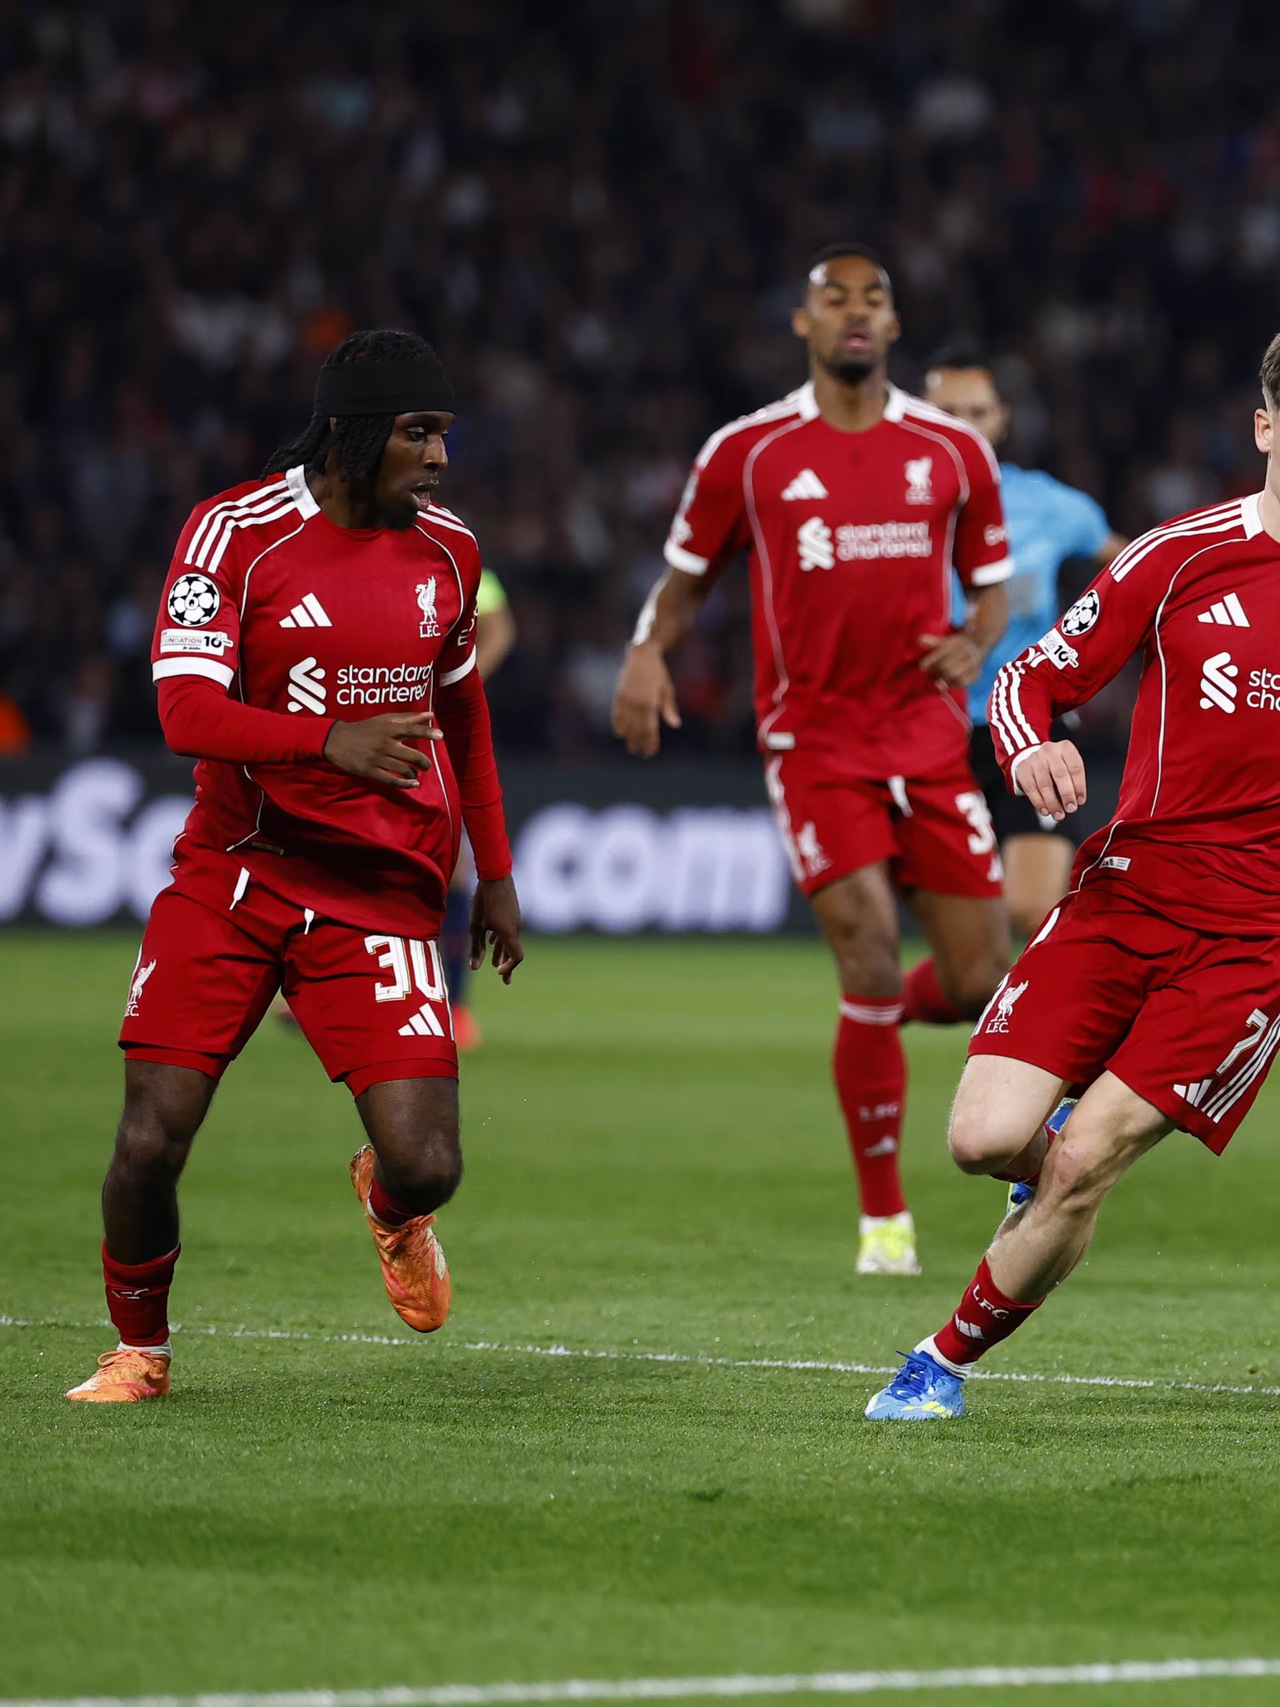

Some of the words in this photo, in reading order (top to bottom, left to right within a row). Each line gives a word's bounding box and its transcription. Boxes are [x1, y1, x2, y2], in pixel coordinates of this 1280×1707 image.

[336, 661, 432, 685] standard
[336, 678, 429, 705] chartered
[364, 935, 445, 1003] 30
[1215, 1008, 1270, 1077] 7
